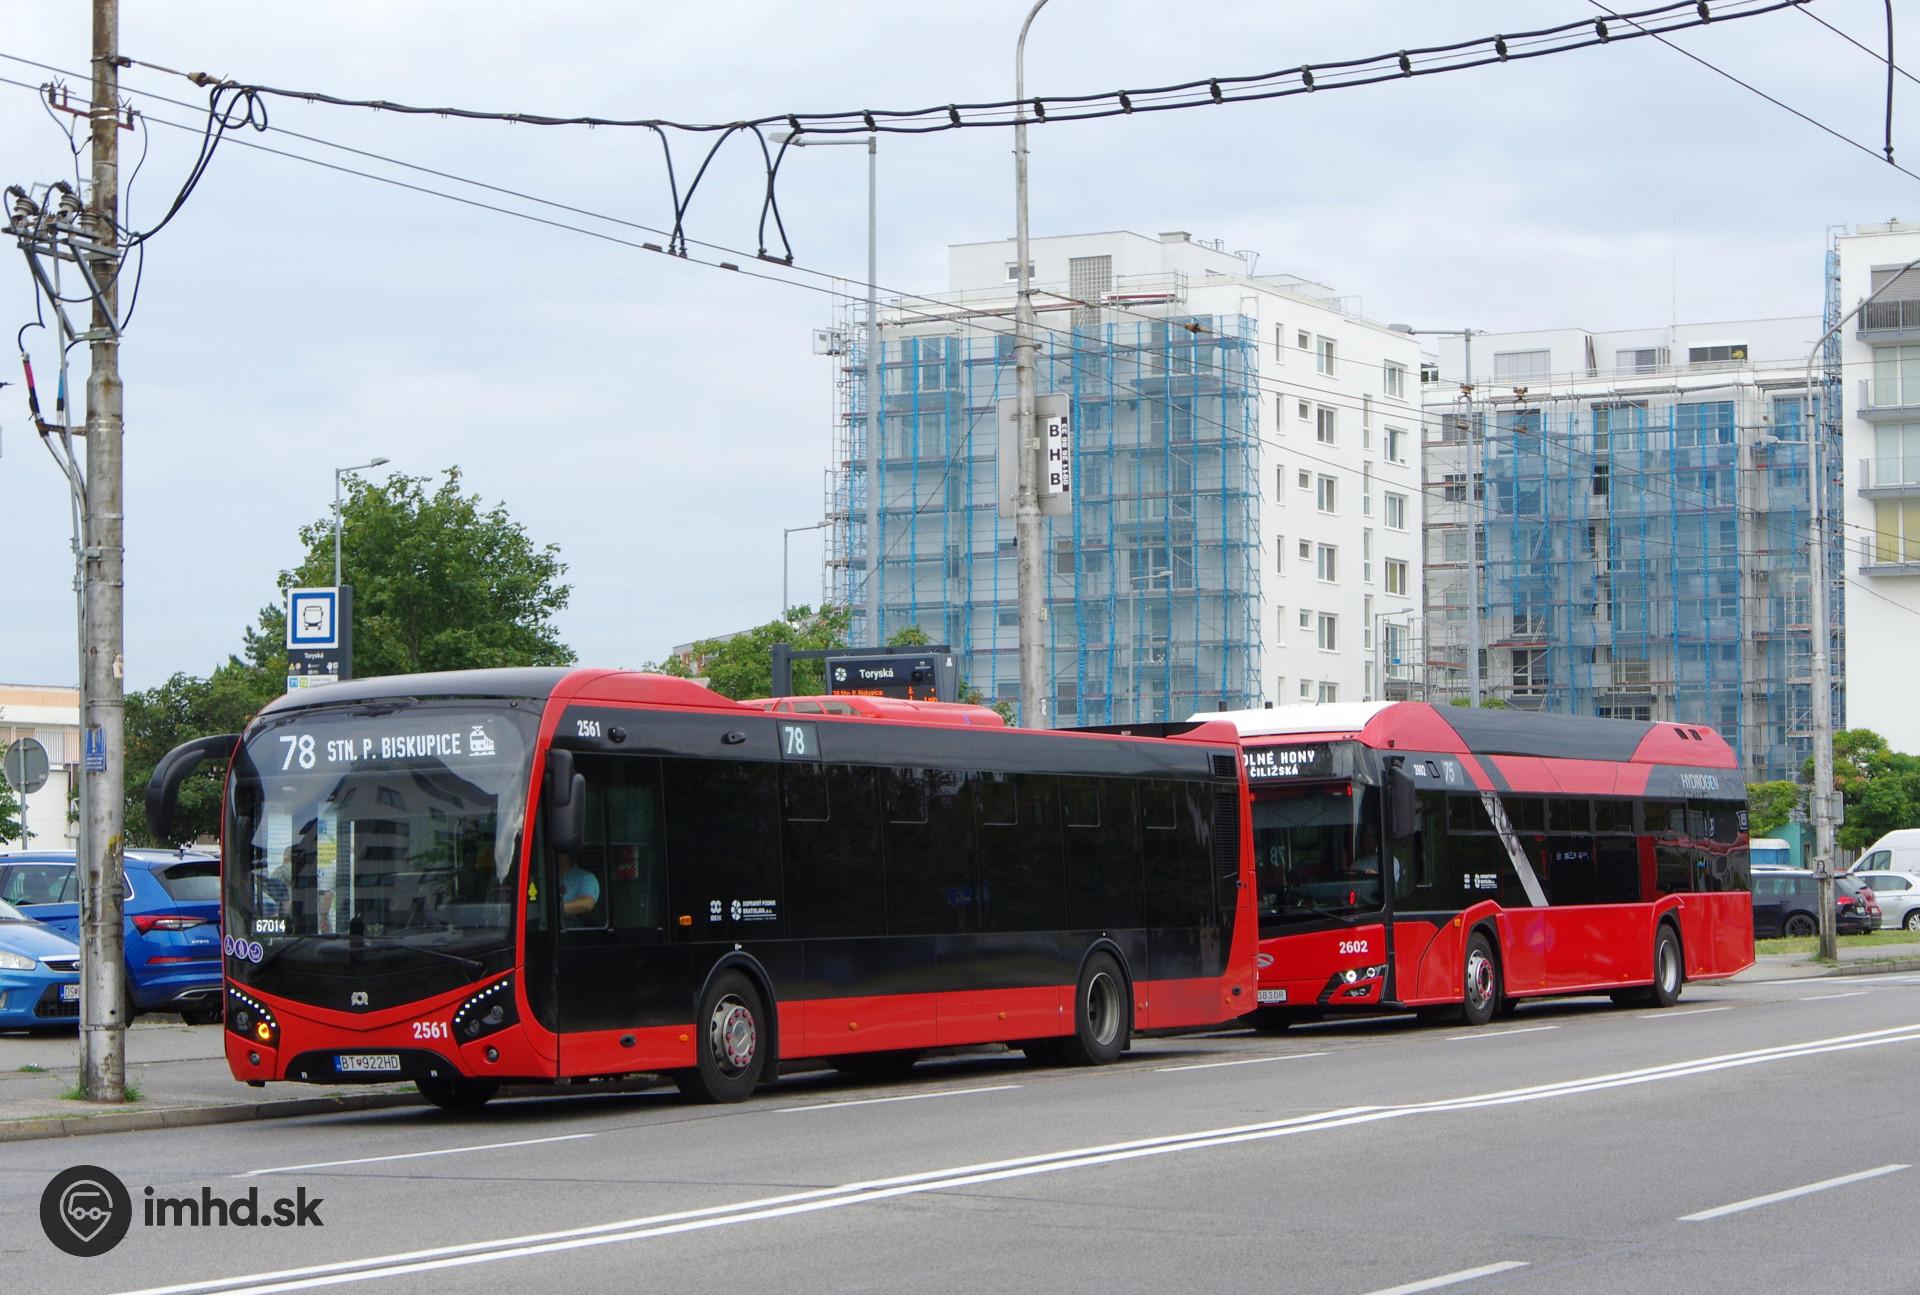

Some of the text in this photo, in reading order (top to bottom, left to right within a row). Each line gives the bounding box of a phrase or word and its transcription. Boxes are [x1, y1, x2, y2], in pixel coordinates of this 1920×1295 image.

[859, 667, 894, 680] Toryská
[576, 720, 601, 738] 2561
[327, 733, 462, 762] STN. P. BISKUPICE
[785, 726, 805, 755] 78
[279, 734, 316, 771] 78
[1243, 750, 1315, 766] OLNÉ HONY
[1250, 764, 1299, 777] ČILIŽSKÁ
[1413, 764, 1427, 777] 2602
[1443, 762, 1455, 783] 75
[1680, 774, 1720, 791] HYDROGEN
[256, 919, 286, 933] 67014
[1339, 940, 1369, 954] 2602
[412, 1022, 448, 1039] 2561
